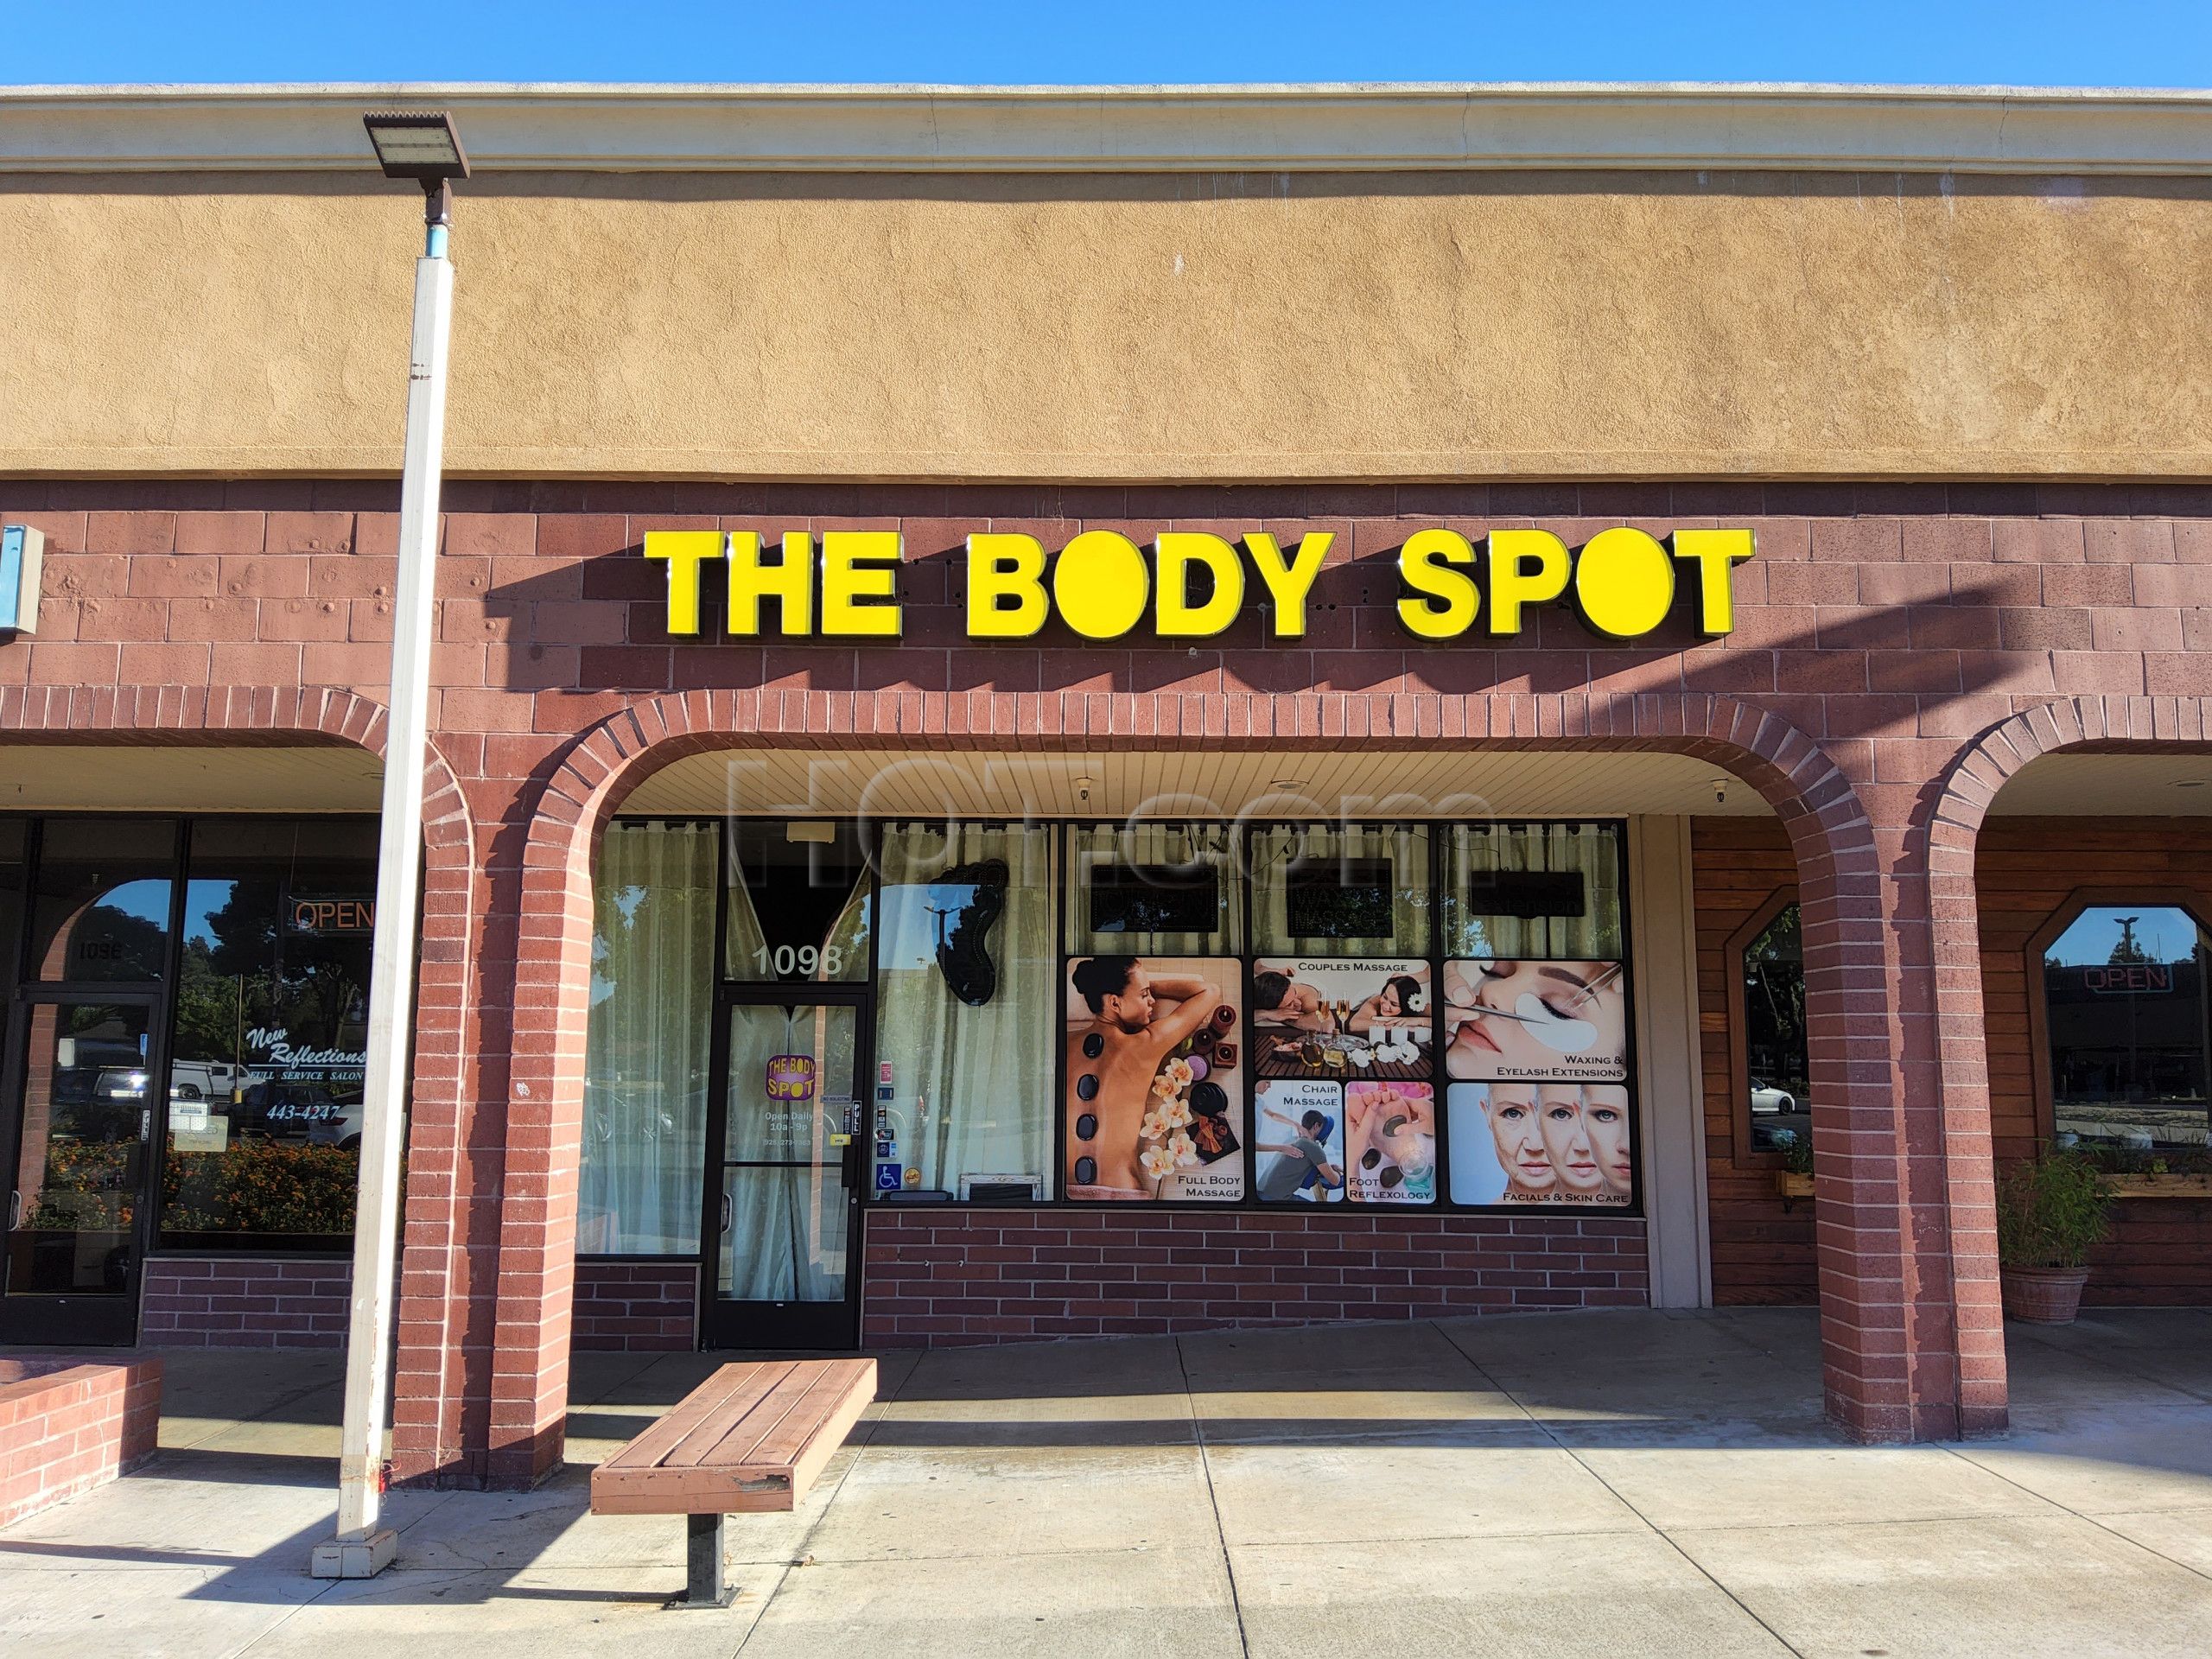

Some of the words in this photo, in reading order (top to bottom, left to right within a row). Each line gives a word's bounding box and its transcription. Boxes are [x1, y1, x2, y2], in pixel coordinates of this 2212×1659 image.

[645, 530, 904, 639] THE
[967, 529, 1337, 642] BODY
[1397, 526, 1758, 641] SPOT
[295, 902, 374, 929] OPEN
[751, 944, 842, 975] 1098
[2084, 967, 2167, 988] OPEN
[246, 1027, 288, 1049] New
[269, 1042, 368, 1070] Reflections
[250, 1071, 275, 1080] FULL
[281, 1071, 324, 1080] SERVICE
[329, 1071, 364, 1080] SALON
[768, 1058, 786, 1077] THE
[790, 1057, 816, 1075] BODY
[767, 1077, 815, 1097] SPOT
[266, 1104, 340, 1121] 443-4247
[765, 1111, 788, 1122] Open
[791, 1111, 813, 1122] Daily
[770, 1122, 788, 1131] 10a
[796, 1122, 808, 1132] 9p
